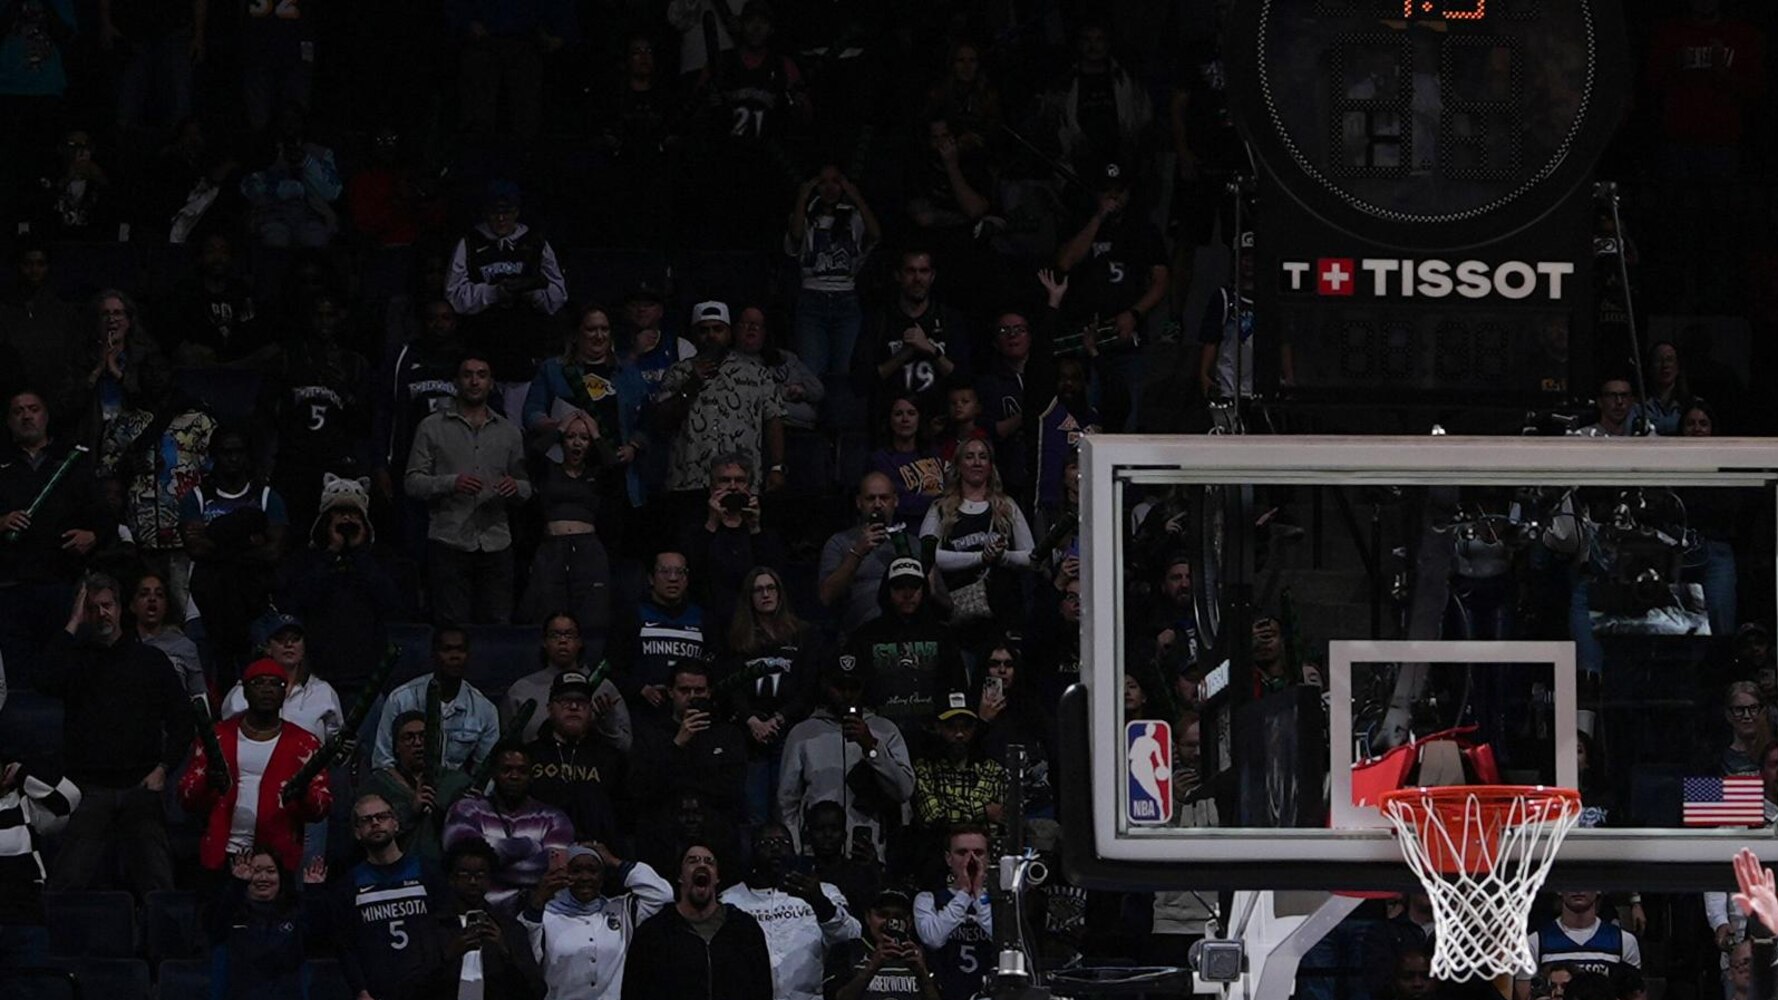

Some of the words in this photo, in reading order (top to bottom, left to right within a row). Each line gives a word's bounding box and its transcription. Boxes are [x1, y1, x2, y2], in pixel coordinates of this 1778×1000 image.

[735, 106, 766, 136] 21
[1107, 261, 1124, 283] 5
[1362, 261, 1574, 299] TISSOT
[903, 361, 935, 392] 19
[307, 404, 327, 431] 5
[1133, 799, 1157, 818] NBA
[361, 899, 428, 923] MINNESOTA
[388, 920, 409, 950] 5
[957, 944, 978, 973] 5
